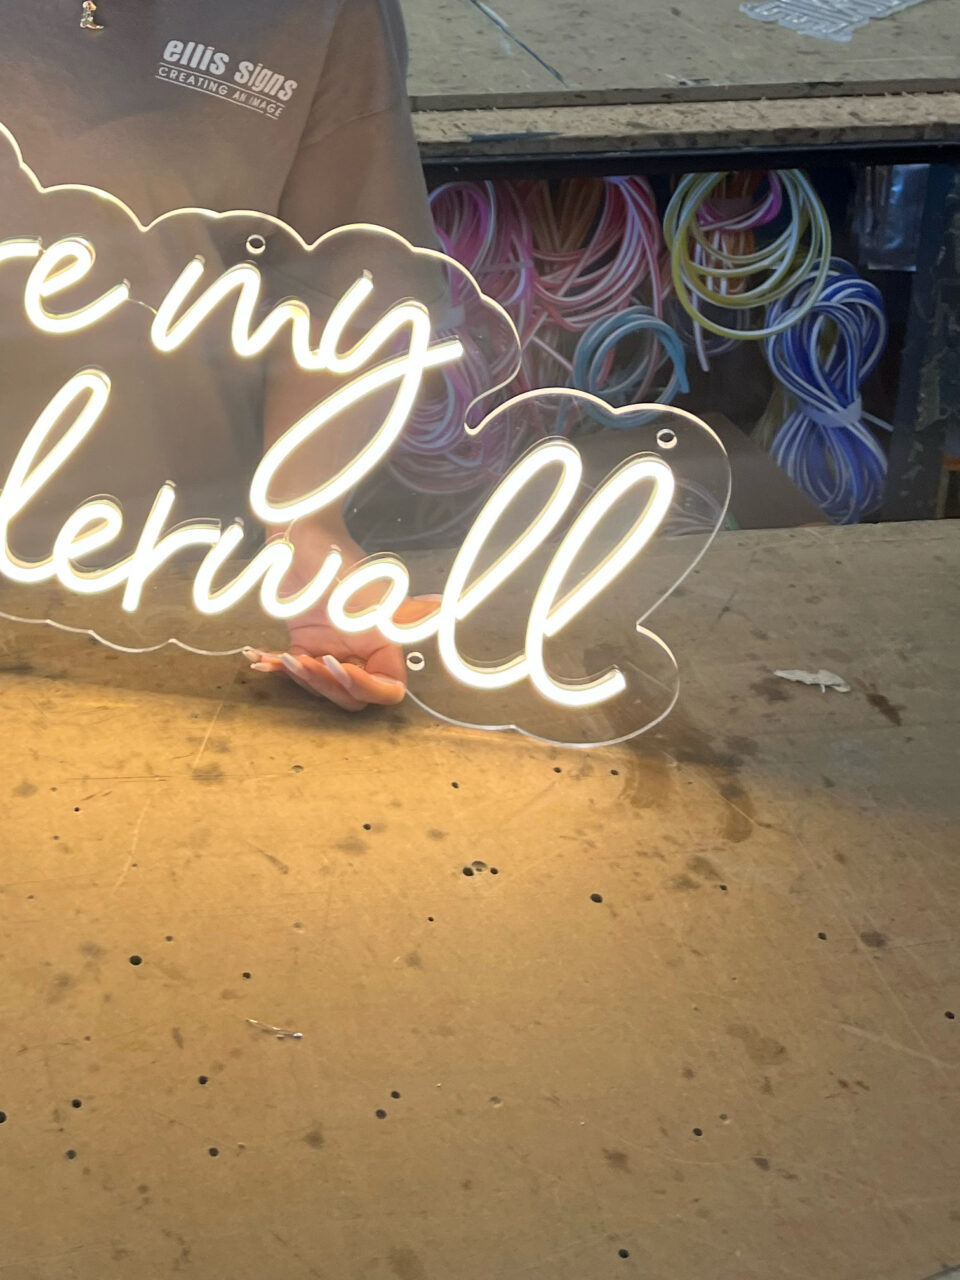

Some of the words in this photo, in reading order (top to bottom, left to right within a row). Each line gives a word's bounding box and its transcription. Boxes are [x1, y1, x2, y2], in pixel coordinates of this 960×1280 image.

[158, 66, 229, 96] CREATING
[231, 90, 247, 102] AN
[248, 96, 284, 117] IMAGE
[162, 39, 230, 76] ellis
[233, 60, 298, 102] signs
[150, 253, 465, 524] my
